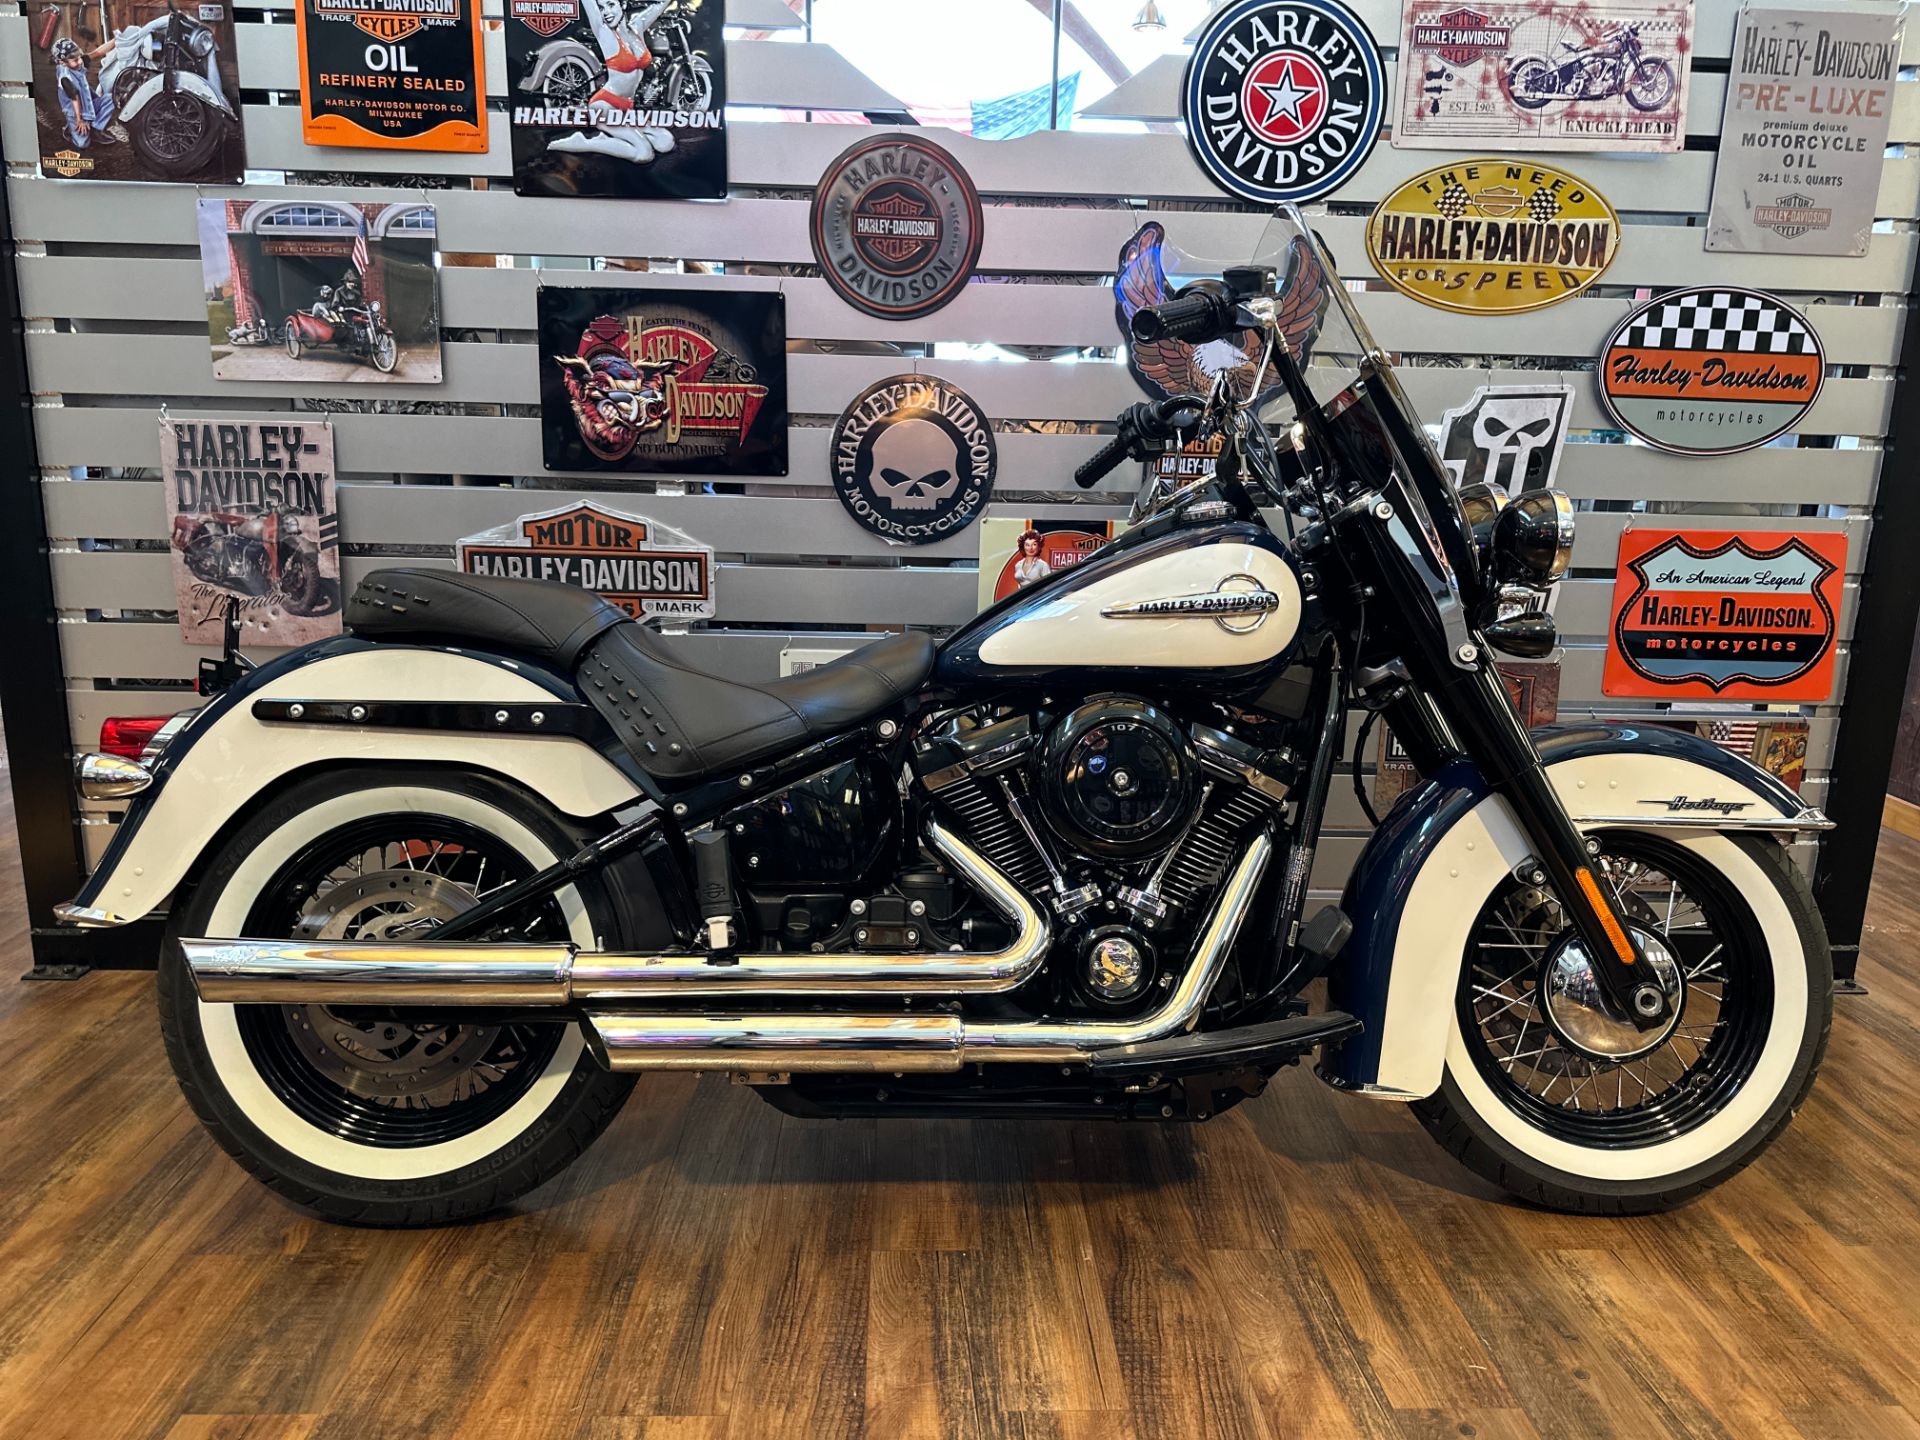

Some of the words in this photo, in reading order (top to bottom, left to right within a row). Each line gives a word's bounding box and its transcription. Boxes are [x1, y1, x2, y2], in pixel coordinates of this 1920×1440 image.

[515, 3, 574, 14] HARLEY-DAVIDSON
[320, 14, 352, 22] TRADE
[426, 19, 457, 27] MARK
[360, 16, 416, 37] CYCLES
[528, 17, 565, 31] CYCLES
[1444, 14, 1482, 27] MOTOR
[1417, 29, 1506, 46] HARLEY-DAVIDSON
[365, 44, 418, 72] OIL
[1442, 49, 1479, 64] CYCLES
[1741, 27, 1896, 80] HARLEY-DAVIDSON
[319, 73, 397, 89] REFINERY
[403, 78, 465, 92] SEALED
[325, 99, 412, 110] HARLEY-DAVIDSON
[415, 103, 447, 112] MOTOR
[450, 105, 467, 113] CO.
[1737, 82, 1886, 118] PRE-LUXE
[369, 110, 423, 119] MILWAUKEE
[513, 107, 721, 129] HARLEY-DAVIDSON
[1564, 119, 1673, 134] KNUCKLEHEAD
[1763, 121, 1809, 133] premium
[1206, 91, 1362, 184] DAVIDSON
[1741, 133, 1867, 152] MOTORCYCLE
[1782, 154, 1817, 169] OIL
[1416, 167, 1480, 195] THE
[1504, 166, 1586, 205] NEED
[1757, 173, 1779, 183] 24-1
[1783, 174, 1802, 184] U.S.
[1805, 175, 1843, 187] QUARTS
[876, 199, 919, 215] MOTOR
[1780, 195, 1810, 208] MOTOR
[1757, 209, 1829, 223] HARLEY-DAVIDSON
[857, 218, 935, 236] HARLEY-DAVIDSON
[1776, 225, 1806, 237] CYCLES
[875, 240, 917, 258] CYCLES
[1379, 213, 1609, 268] HARLEY-DAVIDSON
[838, 256, 955, 301] DAVIDSON
[1398, 267, 1446, 282] FOR
[1446, 269, 1581, 291] SPEED
[626, 315, 700, 366] HARLEY
[1612, 354, 1808, 393] Harley-Davidson
[665, 375, 745, 443] DAVIDSON
[1656, 408, 1764, 425] motorcycles
[837, 382, 990, 480] HARLEY-DAVIDSON
[635, 443, 652, 454] NO
[654, 443, 727, 456] BOUNDARIES
[175, 470, 326, 514] DAVIDSON
[844, 486, 980, 537] MOTORCYCLES
[535, 513, 632, 548] MOTOR
[1078, 537, 1106, 551] MOTO
[1656, 569, 1683, 584] An
[1686, 570, 1751, 585] American
[1754, 570, 1806, 591] Legend
[197, 591, 292, 627] Lierator
[655, 602, 704, 613] MARK
[1138, 595, 1273, 613] HARLEY-DAVIDSON
[1641, 595, 1812, 629] HARLEY-DAVIDSON
[1645, 637, 1797, 653] motorcycles
[1111, 723, 1137, 732] 107
[1384, 763, 1415, 771] TRAD
